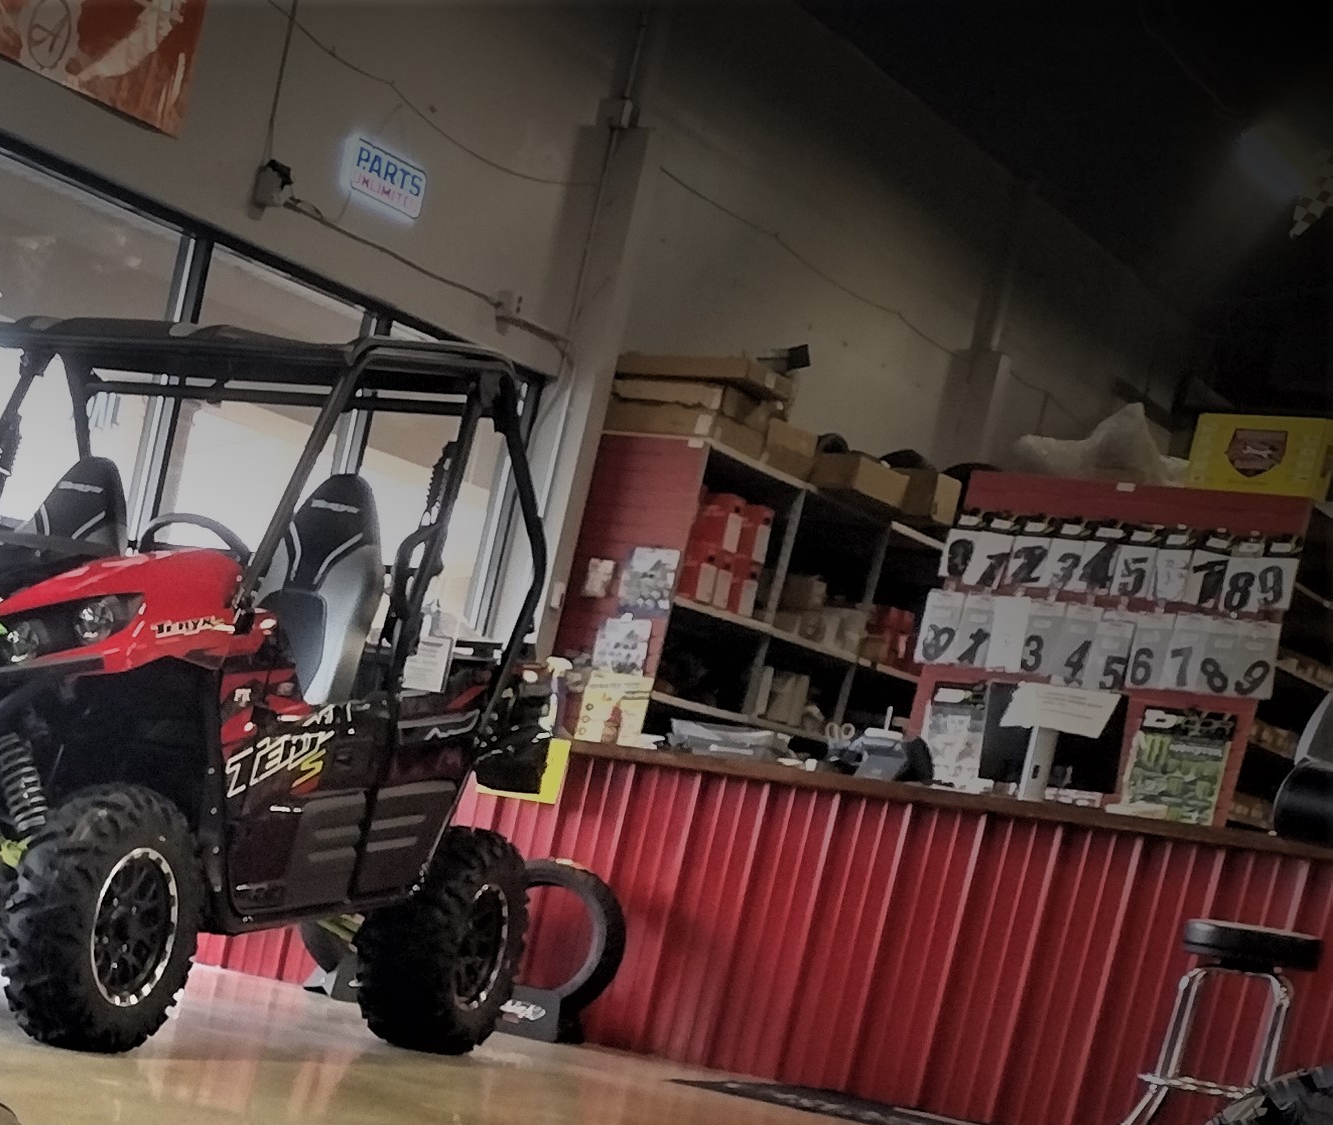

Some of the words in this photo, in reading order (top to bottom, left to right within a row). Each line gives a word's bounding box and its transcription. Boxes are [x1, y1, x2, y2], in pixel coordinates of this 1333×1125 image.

[356, 146, 424, 198] PARTS
[1010, 544, 1048, 583] 2
[1050, 552, 1081, 588] 3
[1079, 542, 1117, 589] 4
[1118, 556, 1149, 597] 5
[1228, 571, 1256, 613] 8
[1258, 565, 1284, 604] 9
[1021, 635, 1045, 672] 3
[1064, 639, 1093, 686] 4
[1099, 655, 1129, 689] 5
[1131, 647, 1154, 686] 6
[1170, 646, 1194, 687] 7
[1200, 657, 1229, 693] 8
[1234, 659, 1271, 695] 9
